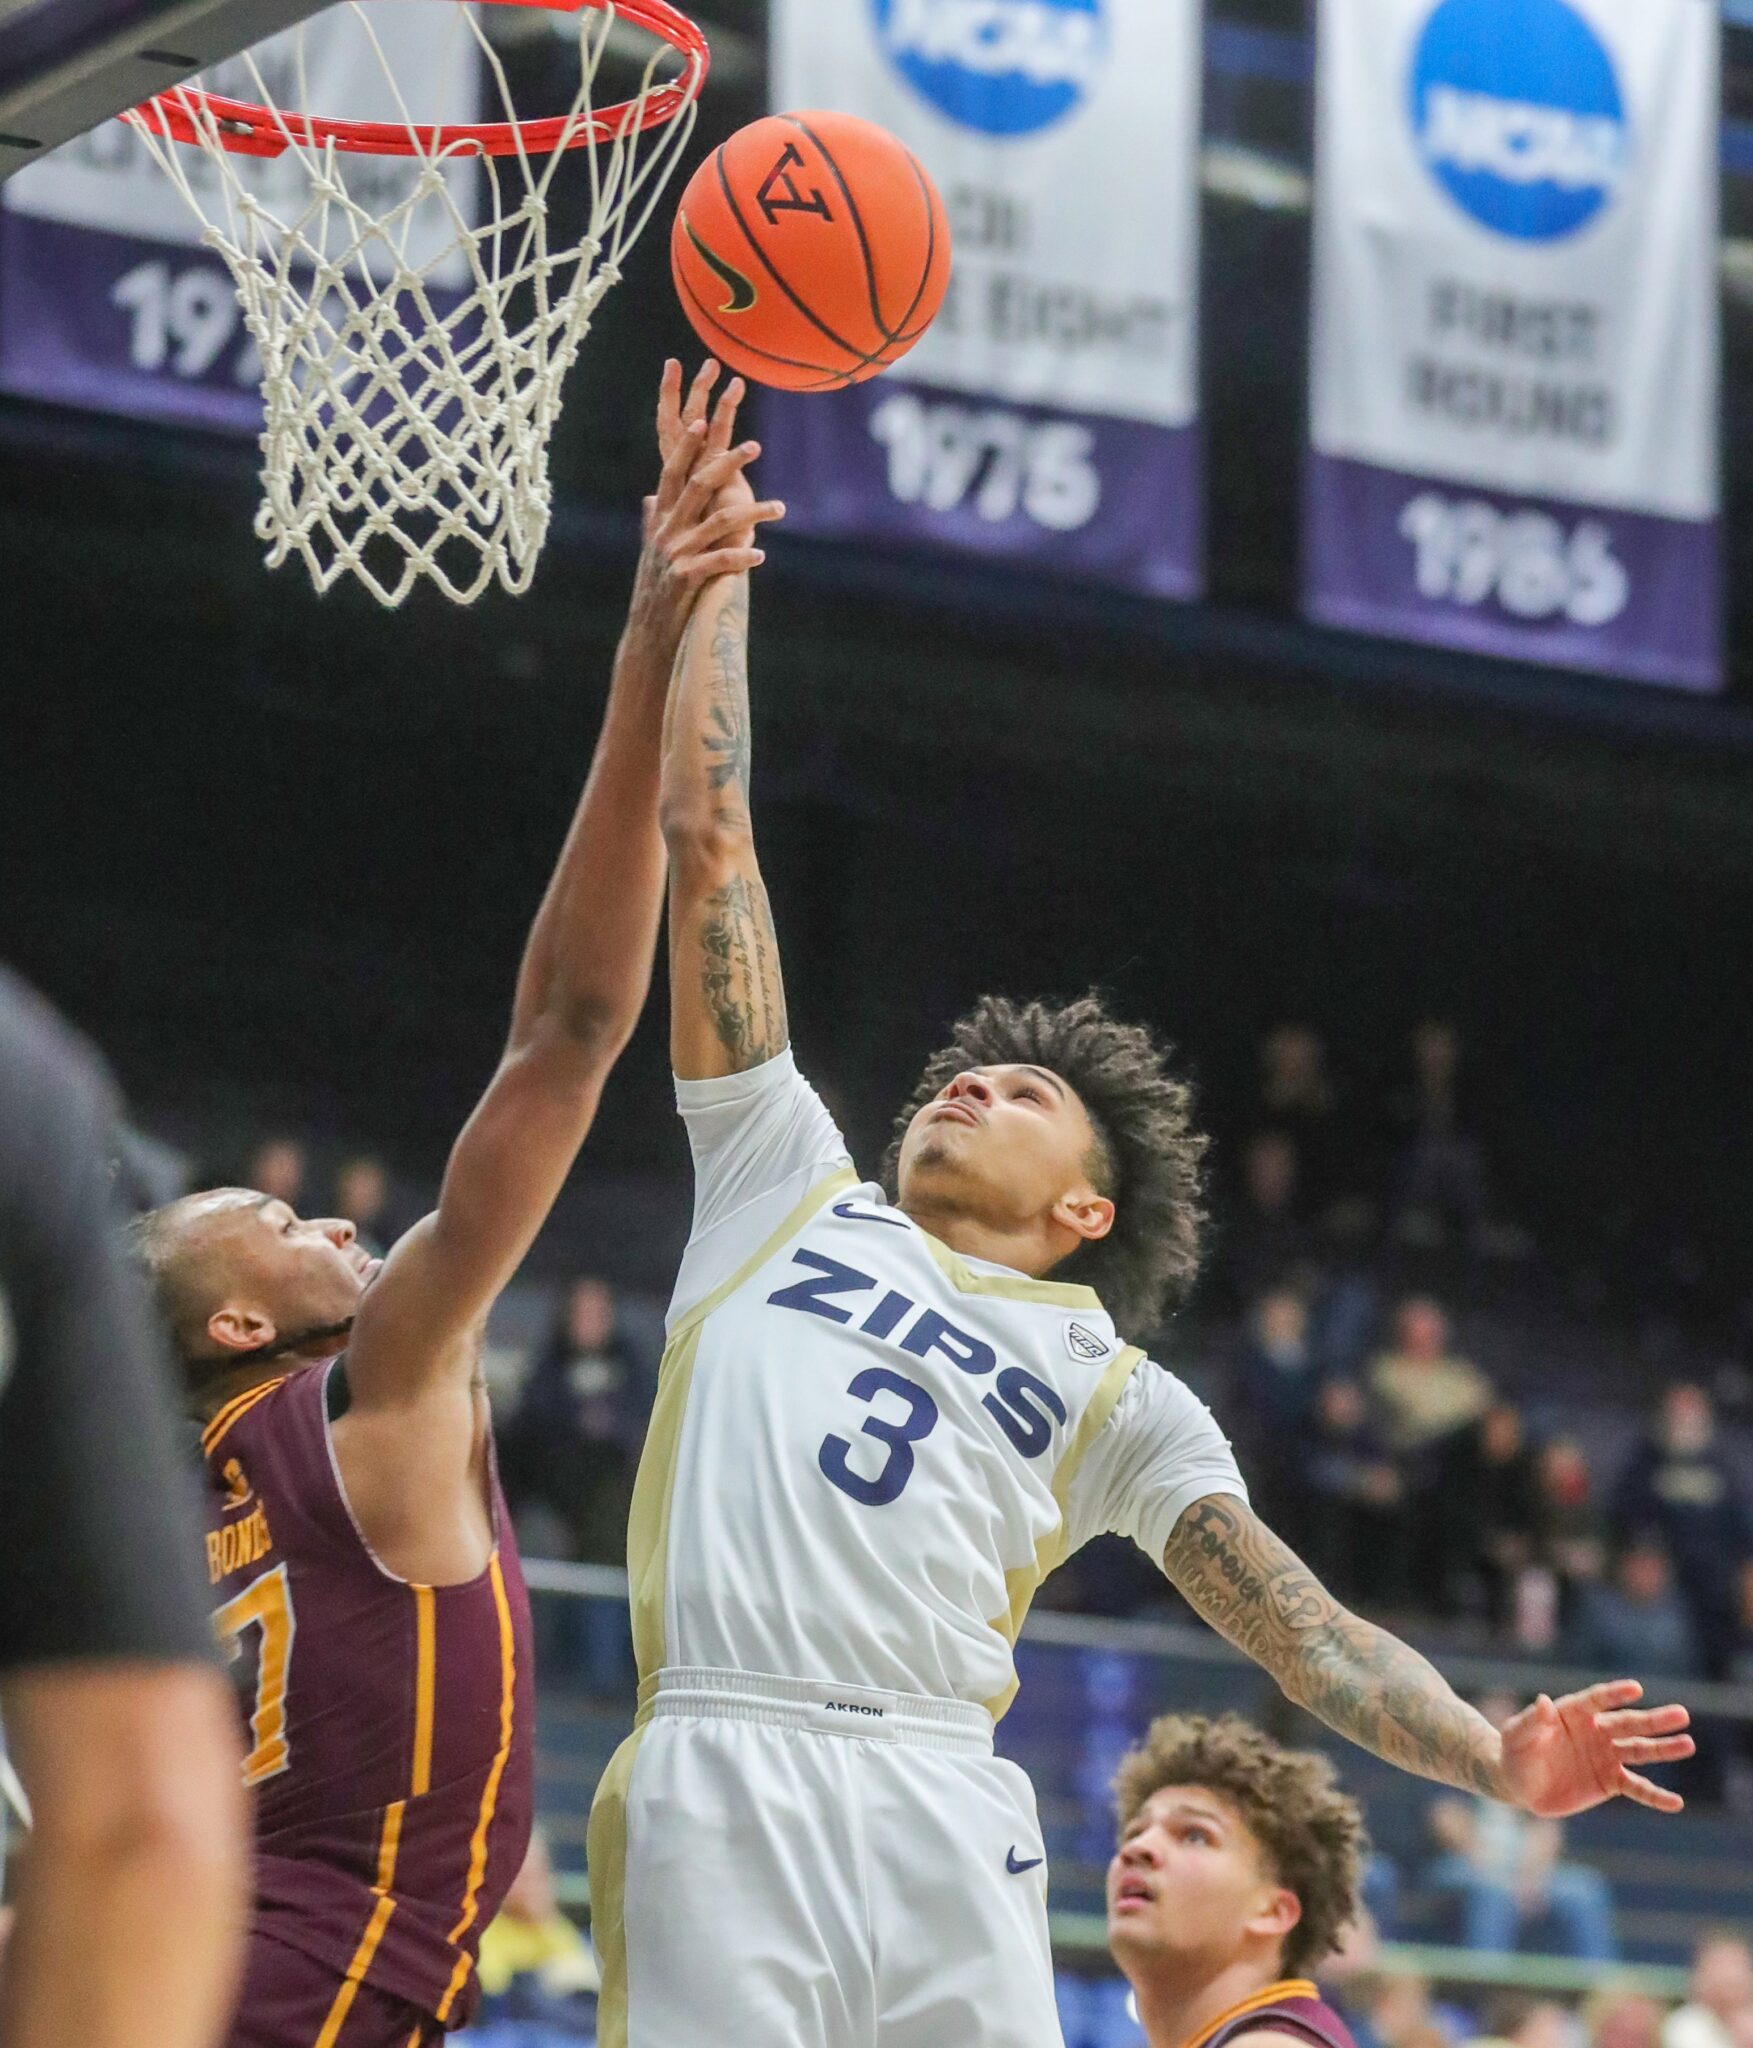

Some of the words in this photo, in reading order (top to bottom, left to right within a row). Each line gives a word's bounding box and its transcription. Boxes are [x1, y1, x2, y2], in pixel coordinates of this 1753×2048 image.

[1412, 84, 1630, 192] NCAA
[1399, 492, 1629, 626] 1986
[768, 1247, 1067, 1459] ZIPS
[819, 1367, 939, 1507] 3
[825, 1700, 884, 1718] AKRON
